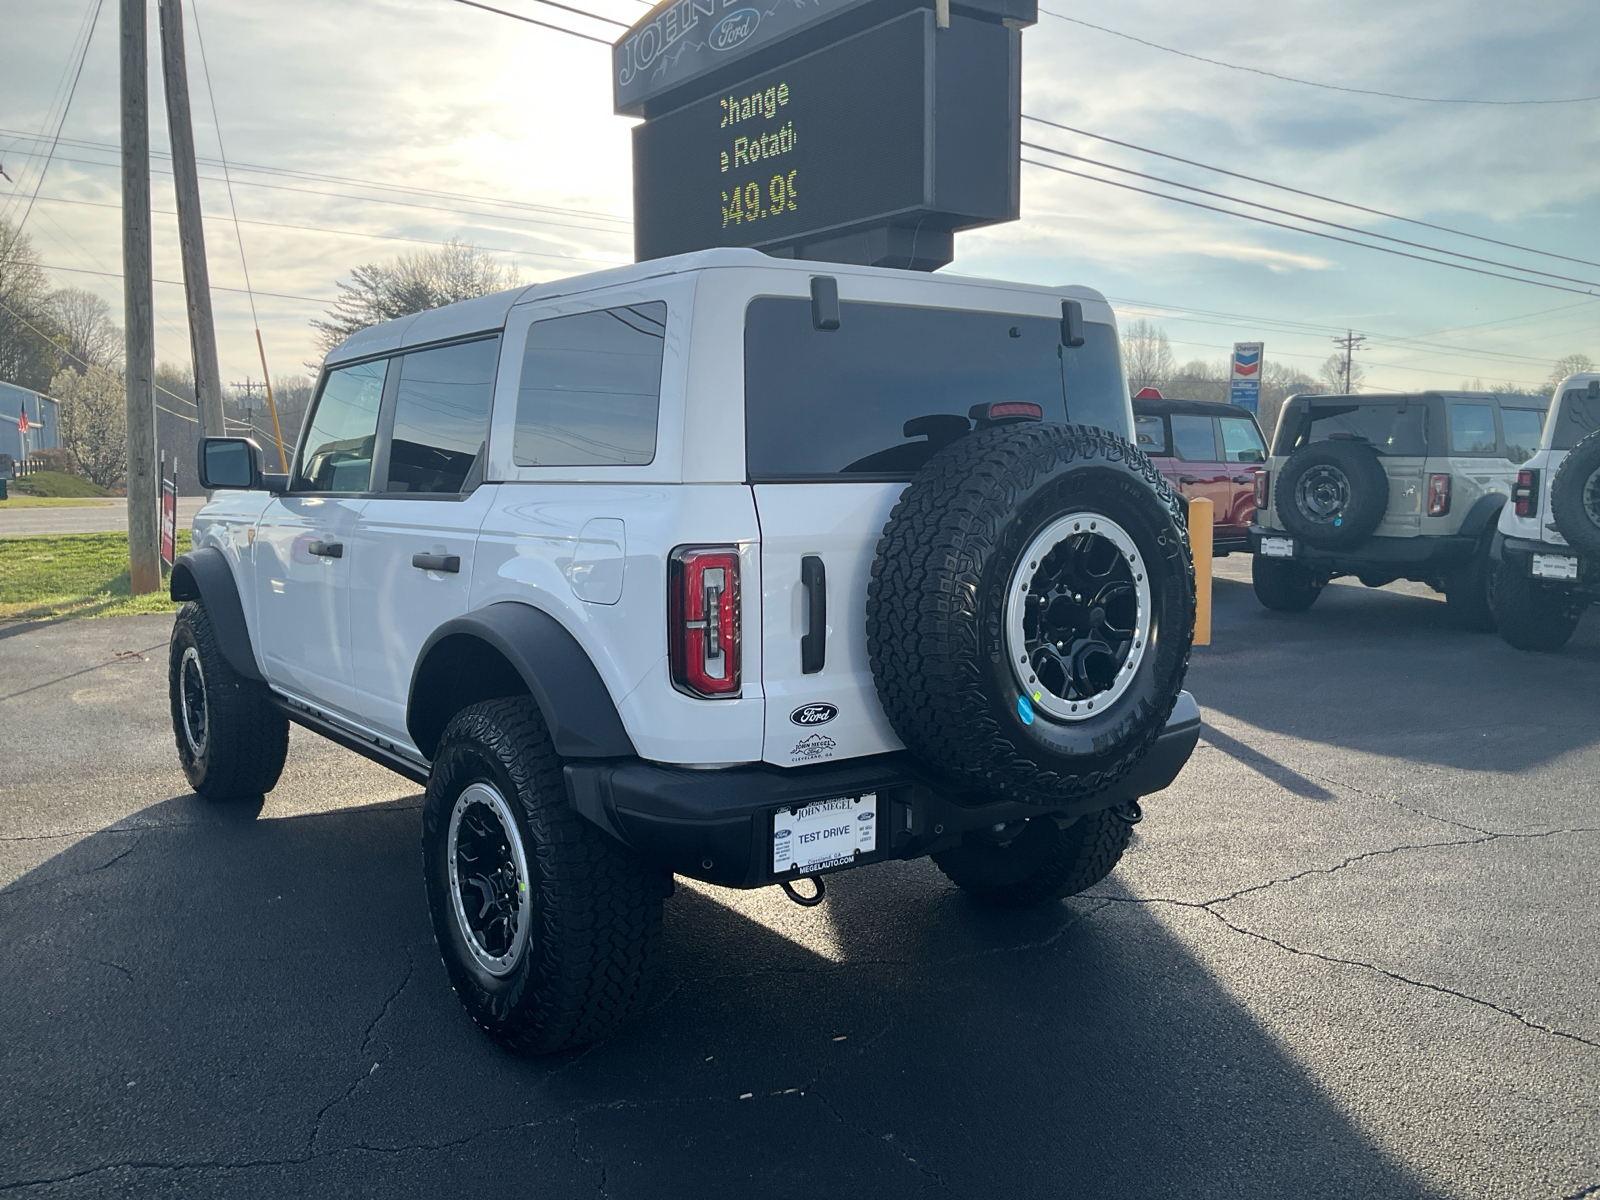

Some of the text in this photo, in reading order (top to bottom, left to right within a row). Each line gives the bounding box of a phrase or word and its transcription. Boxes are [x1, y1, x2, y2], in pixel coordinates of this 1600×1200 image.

[734, 120, 797, 169] Rotati
[795, 742, 810, 751] JOHN
[796, 800, 853, 821] JOHN MEGEL
[798, 831, 821, 844] TEST
[823, 825, 851, 839] DRIVE
[799, 855, 855, 874] MEGELAUTO.COM
